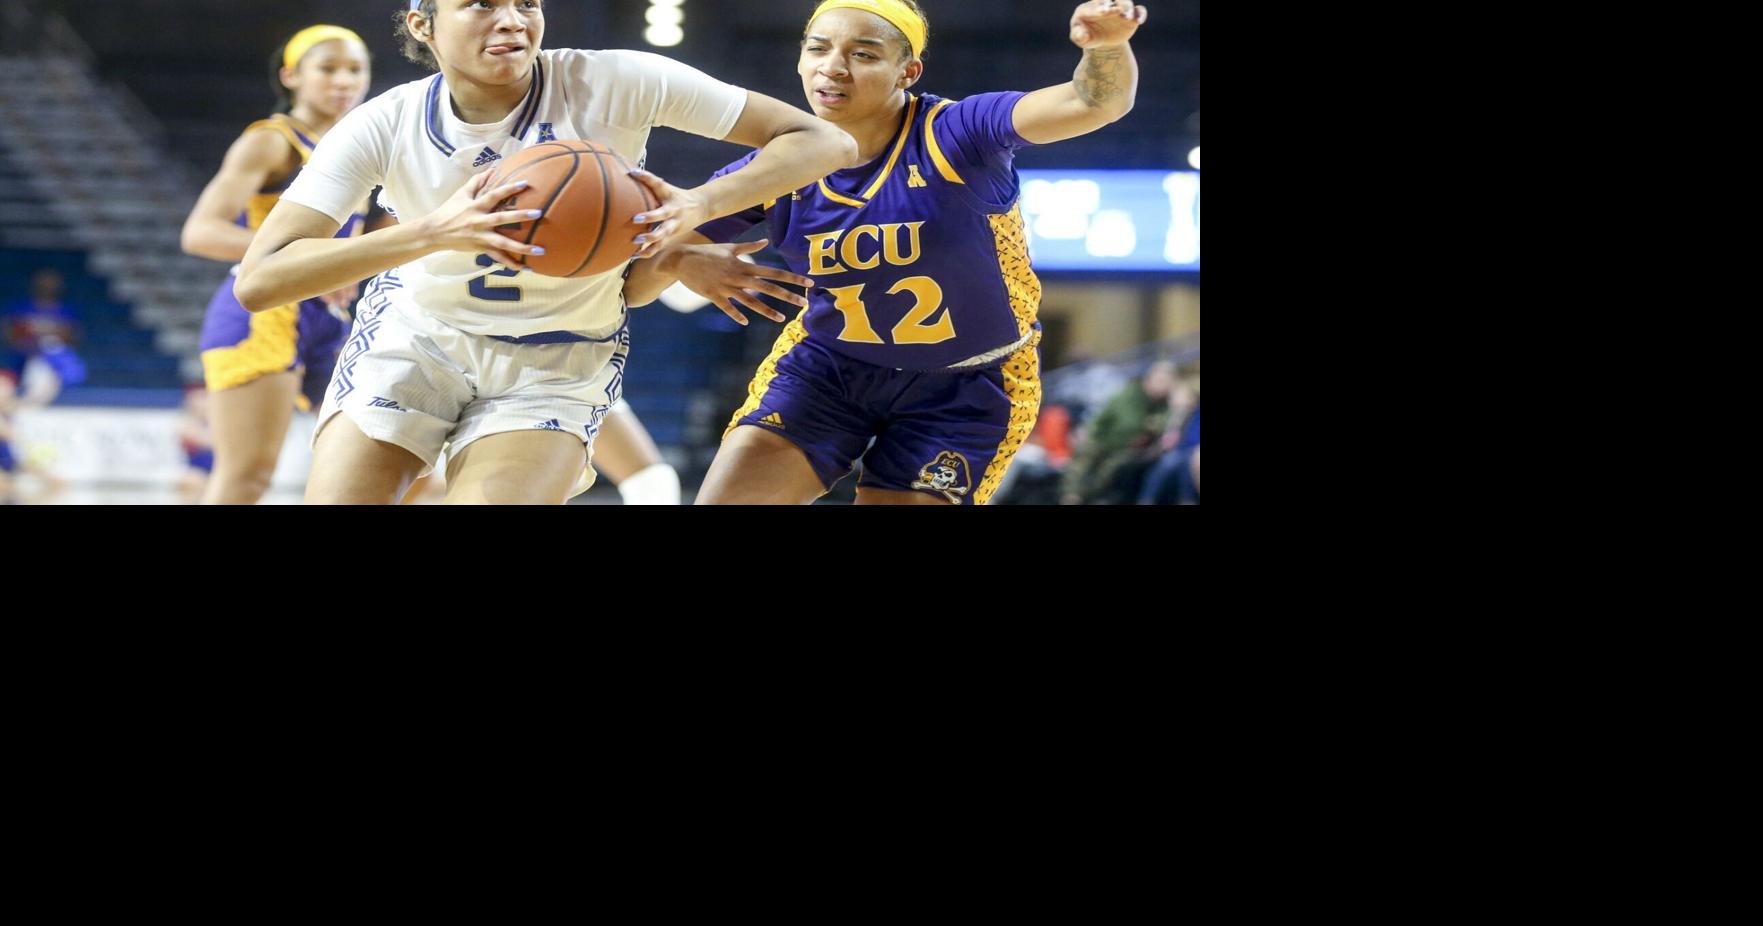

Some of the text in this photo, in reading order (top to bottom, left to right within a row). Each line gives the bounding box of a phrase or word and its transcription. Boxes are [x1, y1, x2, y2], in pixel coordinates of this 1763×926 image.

[473, 153, 502, 168] adidas
[804, 220, 926, 276] ECU
[467, 253, 523, 303] 2
[819, 275, 957, 345] 12
[940, 458, 961, 469] ECU
